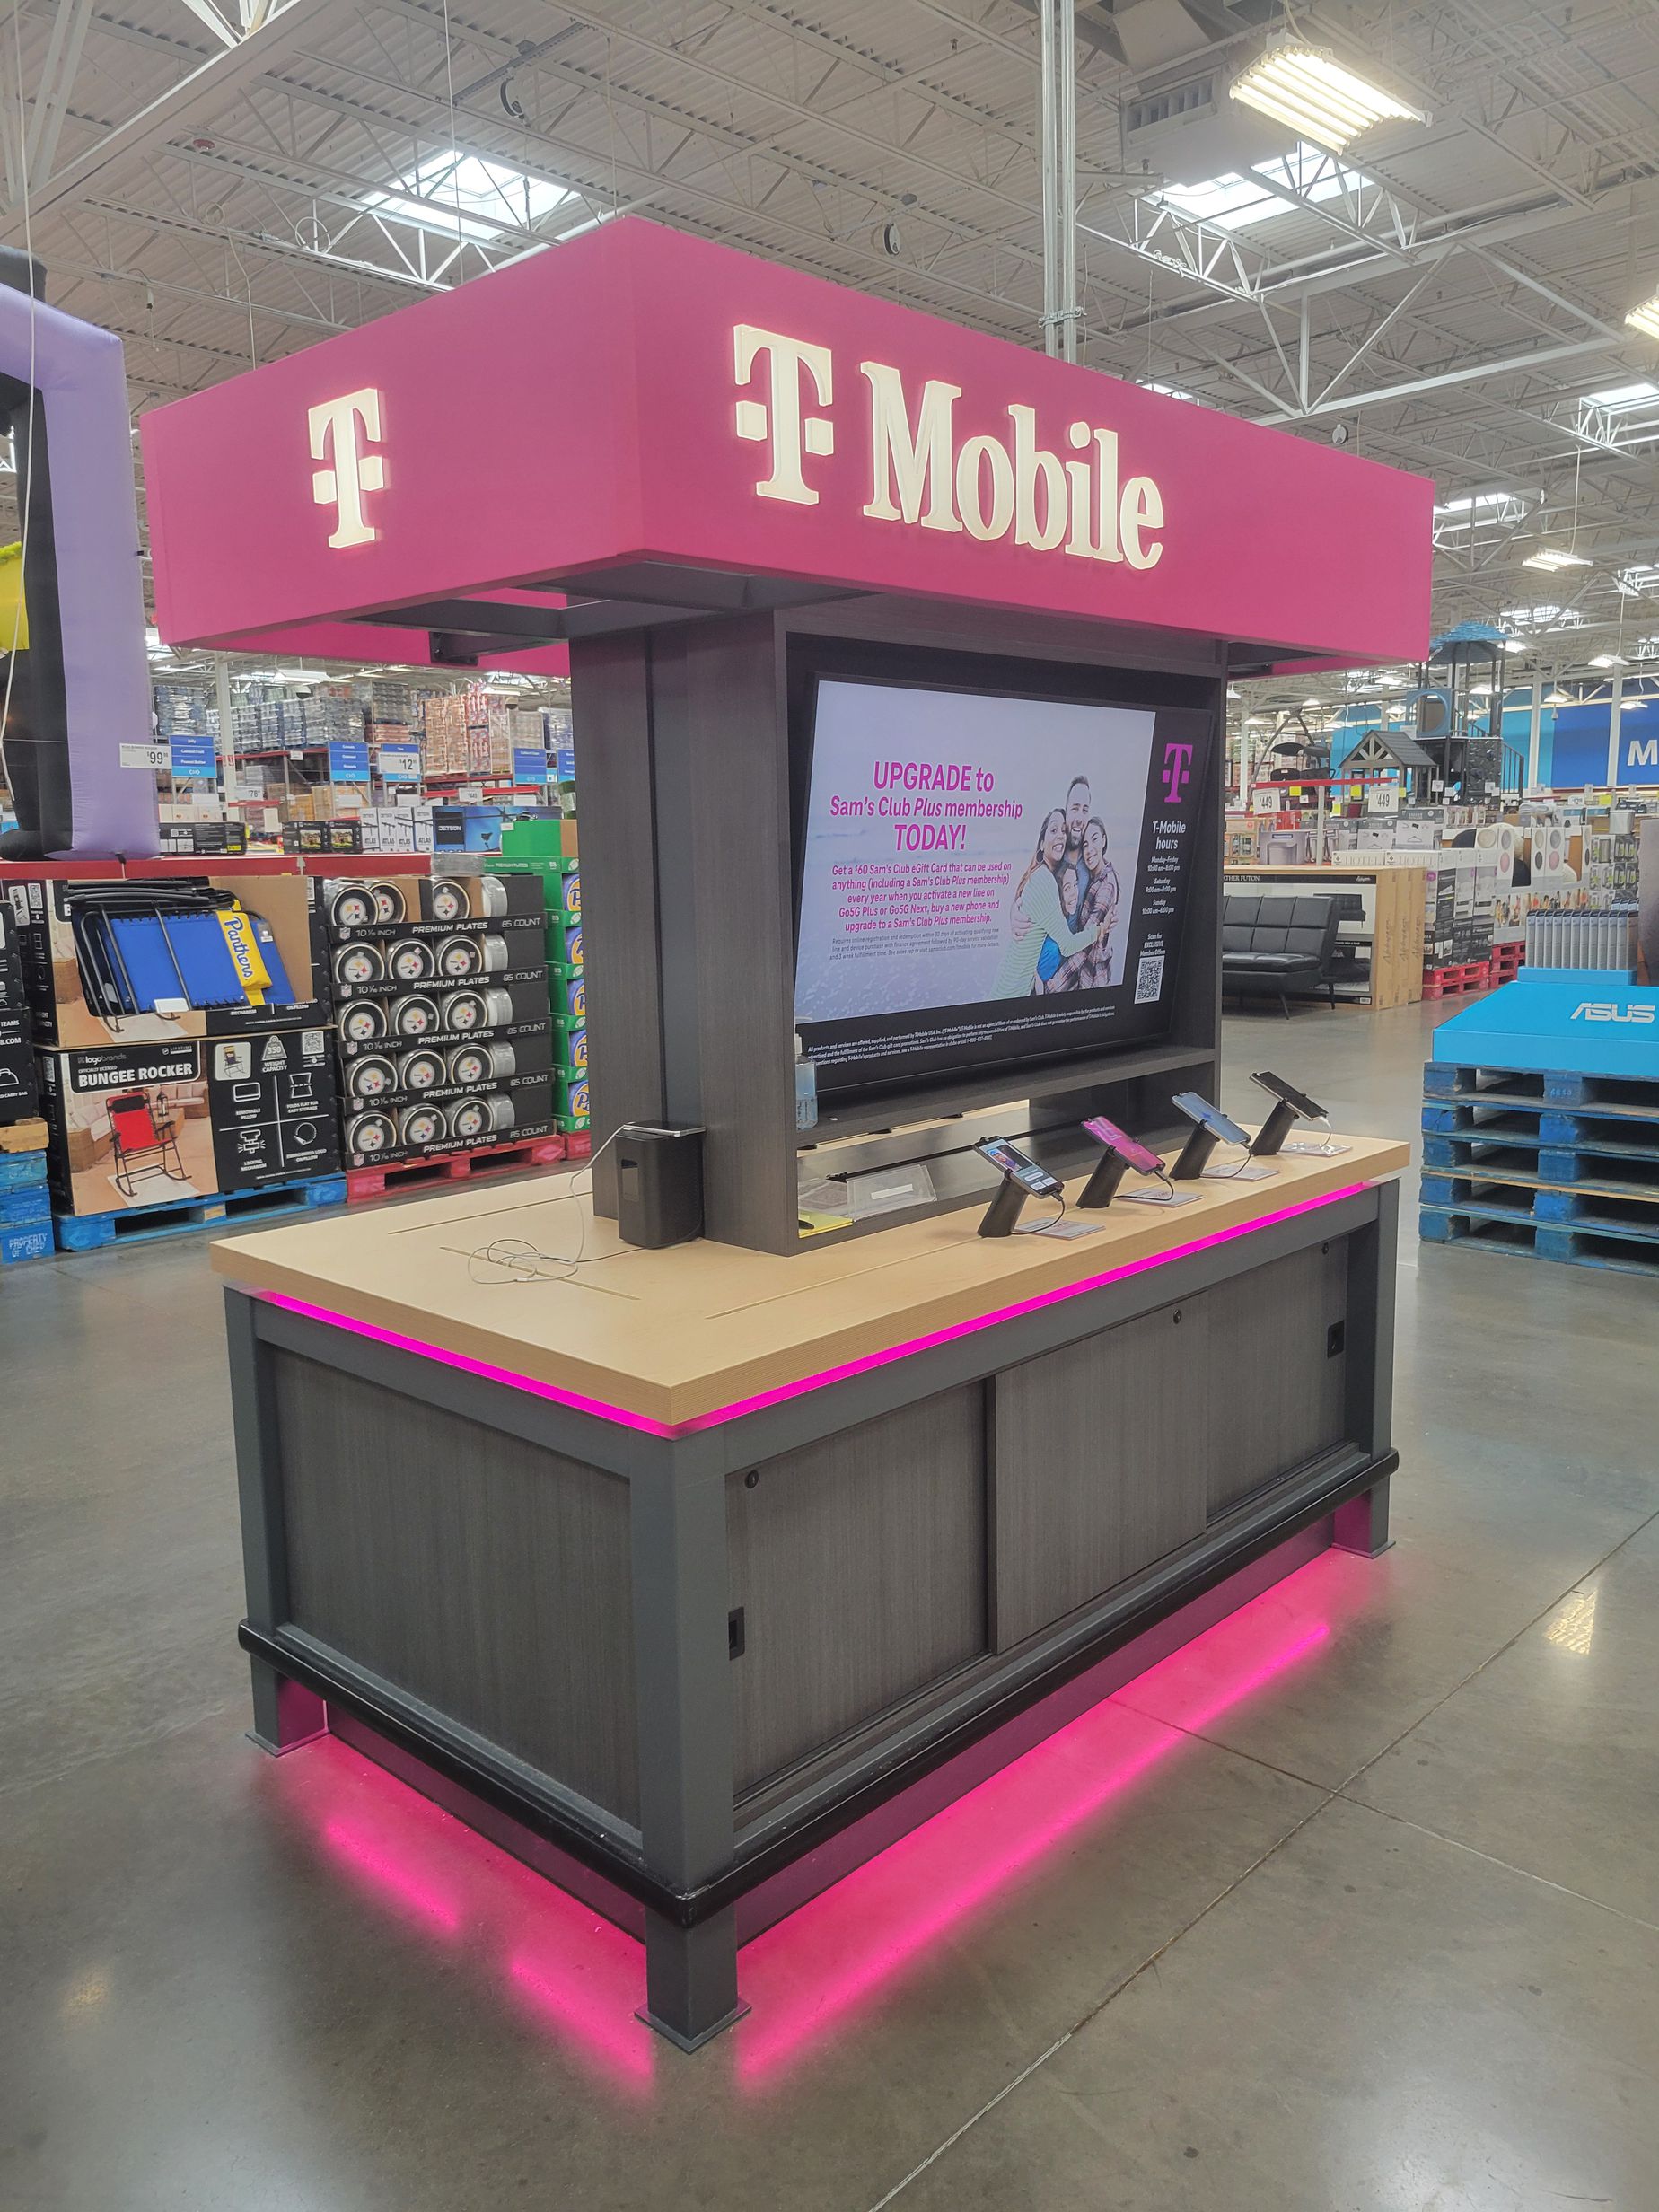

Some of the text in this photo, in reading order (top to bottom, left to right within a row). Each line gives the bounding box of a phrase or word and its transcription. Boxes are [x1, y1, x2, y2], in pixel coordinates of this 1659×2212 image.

[861, 360, 1166, 571] Mobile
[873, 761, 995, 793] UPGRADE to
[830, 795, 1023, 820] Sam's Club Plus membership
[894, 823, 967, 851] TODAY!
[1153, 820, 1186, 834] T-Mobile
[1155, 837, 1179, 850] hours
[832, 865, 847, 875] Get
[848, 867, 853, 875] a
[855, 865, 868, 875] $60
[870, 864, 891, 874] Sam's
[893, 864, 909, 873] Club
[911, 863, 929, 873] eGift
[931, 863, 947, 873] Card
[949, 863, 963, 873] that
[978, 862, 986, 871] be
[988, 862, 1003, 871] used
[1004, 863, 1012, 871] on
[832, 879, 866, 891] anything
[868, 877, 905, 891] (including
[912, 876, 933, 886] Sam's
[935, 876, 951, 886] Club
[952, 875, 965, 885] Plus
[967, 873, 1009, 885] membership)
[847, 894, 868, 904] every
[870, 894, 887, 904] year
[889, 891, 908, 901] when
[909, 892, 922, 902] you
[924, 890, 952, 900] activate
[959, 890, 972, 898] new
[973, 888, 986, 897] line
[839, 907, 860, 917] Go5G
[862, 906, 878, 916] Plus
[890, 904, 909, 915] Go5G
[911, 904, 929, 914] Next,
[931, 903, 944, 914] buy
[966, 901, 986, 912] phone
[988, 900, 999, 908] and
[412, 925, 453, 934] PREMIUM
[456, 922, 488, 931] PLATES
[501, 920, 513, 928] 85
[514, 917, 541, 926] COUNT
[846, 919, 876, 933] upgrade
[879, 920, 886, 928] to
[893, 917, 915, 927] Sam's
[917, 917, 933, 926] Club
[934, 916, 948, 926] Plus
[949, 913, 992, 925] membership.
[224, 916, 253, 978] Panthers
[413, 979, 455, 989] PREMIUM
[458, 977, 489, 987] PLATES
[515, 970, 543, 980] COUNT
[1570, 1003, 1655, 1023] ASUS
[384, 1040, 402, 1049] INCH
[418, 1034, 459, 1045] PREMIUM
[461, 1031, 495, 1040] PLATES
[507, 1027, 518, 1035] 85
[520, 1023, 546, 1033] COUNT
[78, 1063, 193, 1088] BUNGEE ROCKER
[262, 1065, 287, 1073] CAPACITY
[389, 1095, 408, 1103] INCH
[423, 1088, 464, 1099] PREMIUM
[466, 1083, 497, 1093] PLATES
[522, 1075, 549, 1084] COUNT
[390, 1150, 408, 1158] INCH
[423, 1143, 464, 1153] PREMIUM
[466, 1135, 497, 1146] PLATES
[510, 1130, 520, 1138] 85
[522, 1126, 549, 1136] COUNT
[9, 1233, 48, 1249] PROPERTY
